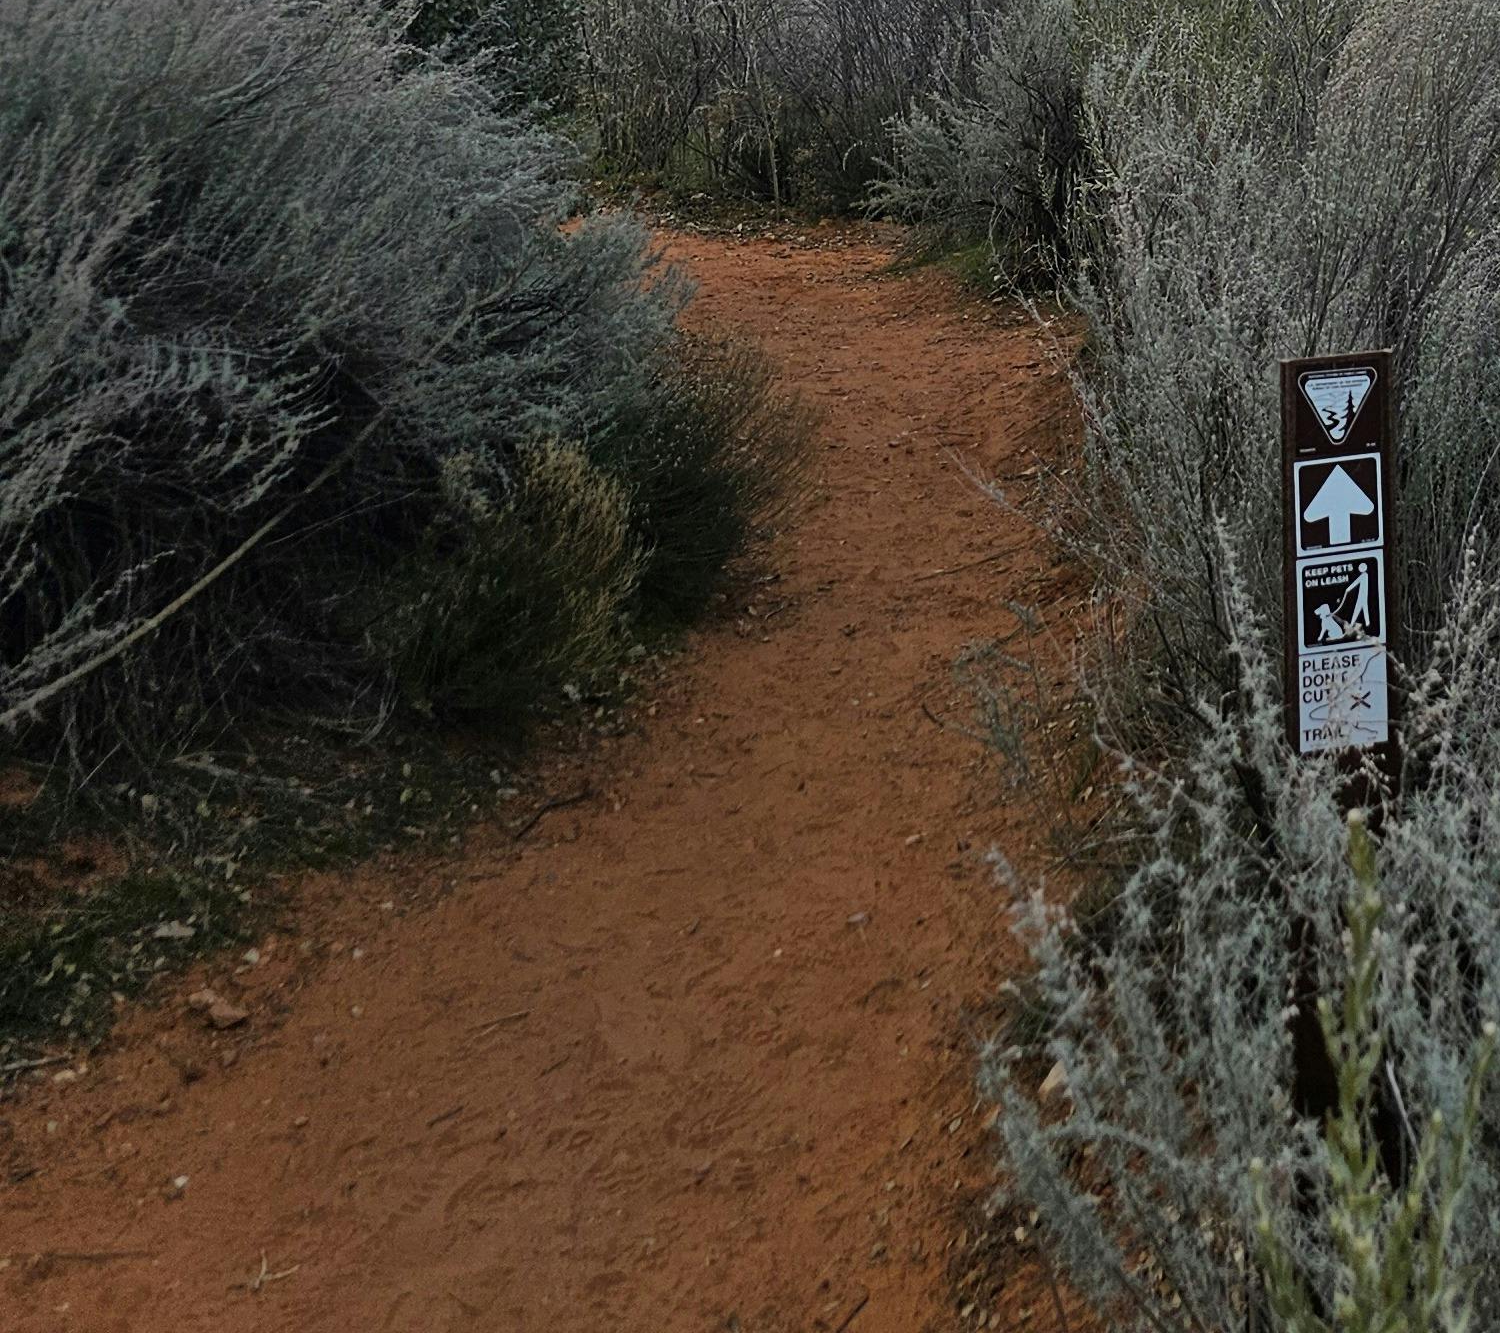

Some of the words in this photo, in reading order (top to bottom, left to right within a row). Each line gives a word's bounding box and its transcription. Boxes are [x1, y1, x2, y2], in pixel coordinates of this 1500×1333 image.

[1305, 566, 1329, 578] KEEP
[1330, 563, 1354, 574] PETS
[1305, 578, 1319, 588] ON
[1320, 574, 1349, 586] LEASH
